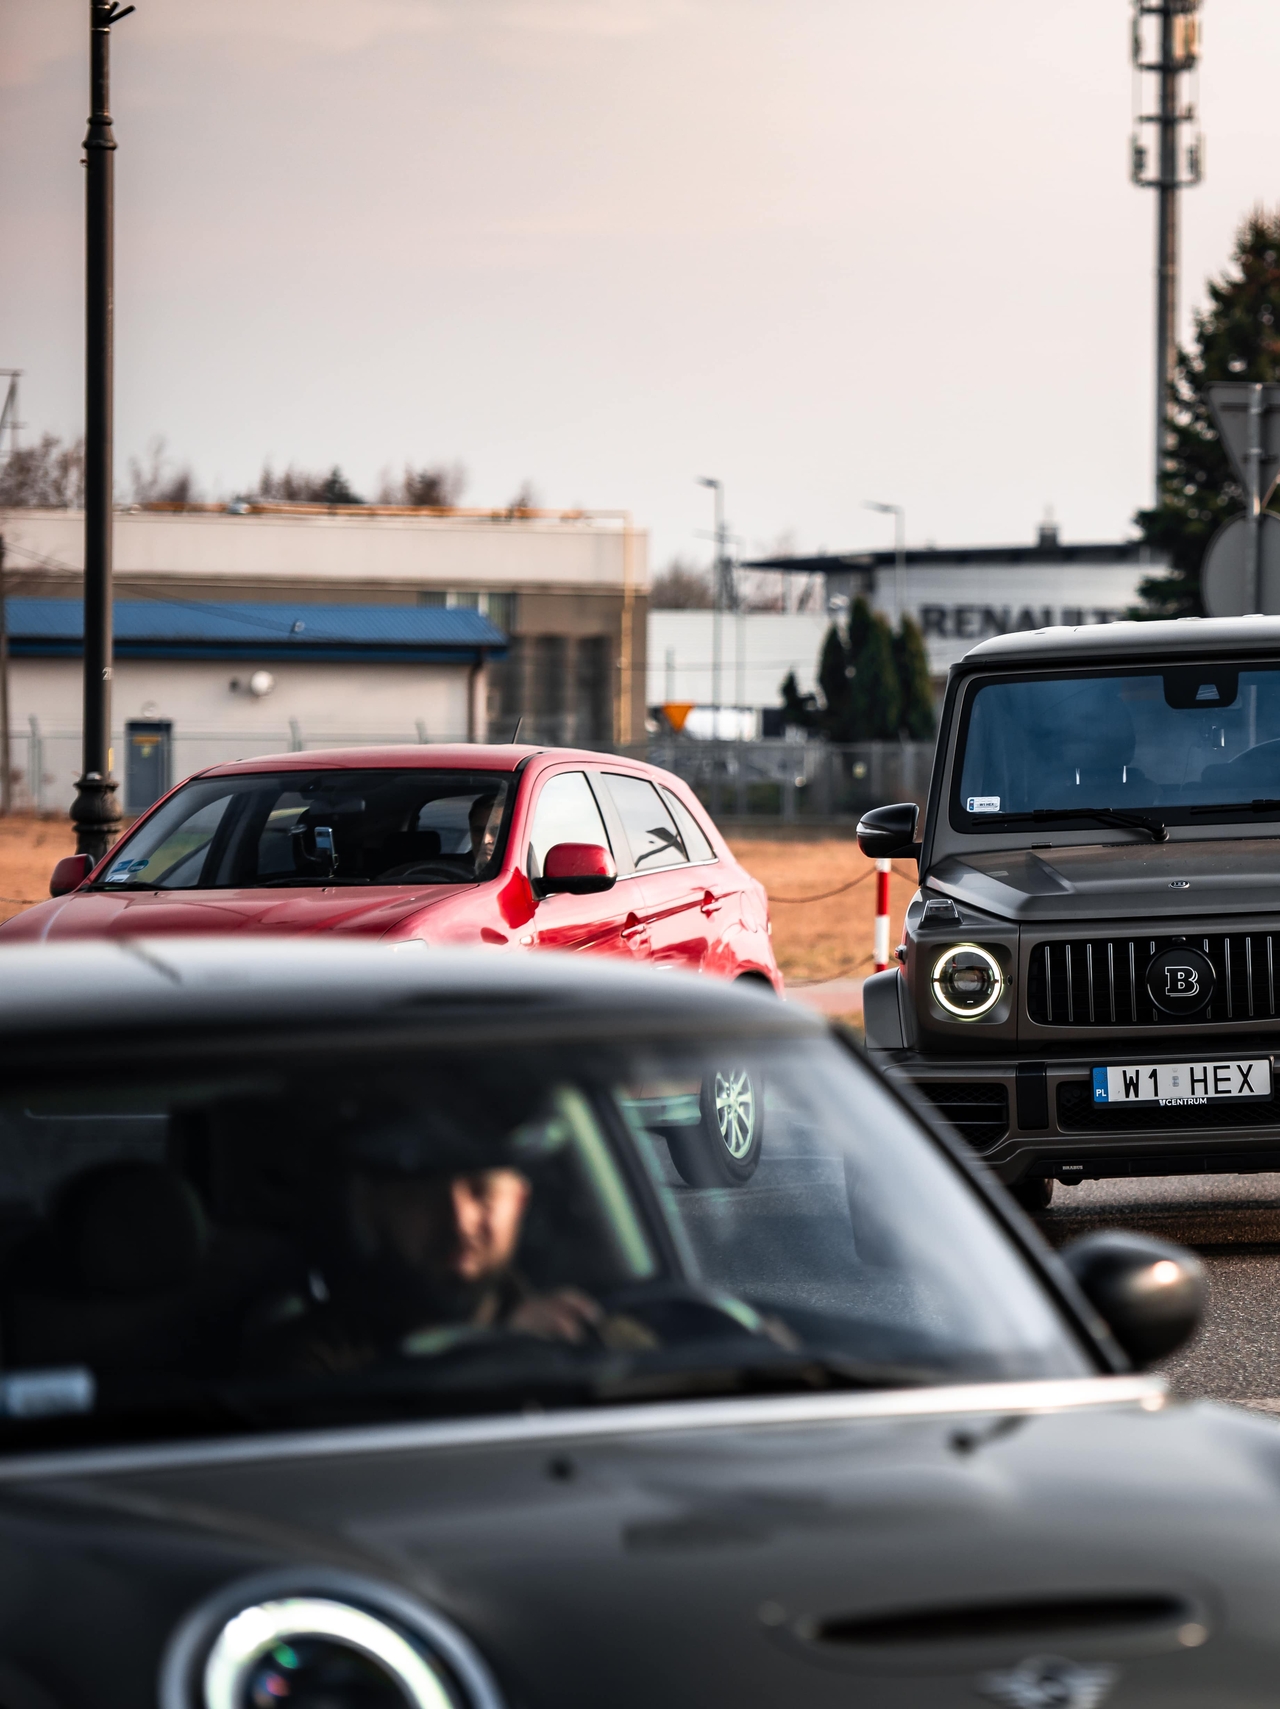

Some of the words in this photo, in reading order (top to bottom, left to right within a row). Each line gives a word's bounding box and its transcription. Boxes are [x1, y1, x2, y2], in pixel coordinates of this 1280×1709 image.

[1165, 966, 1200, 997] B
[1096, 1089, 1107, 1097] PL
[1122, 1068, 1159, 1098] W1
[1190, 1064, 1255, 1096] HEX
